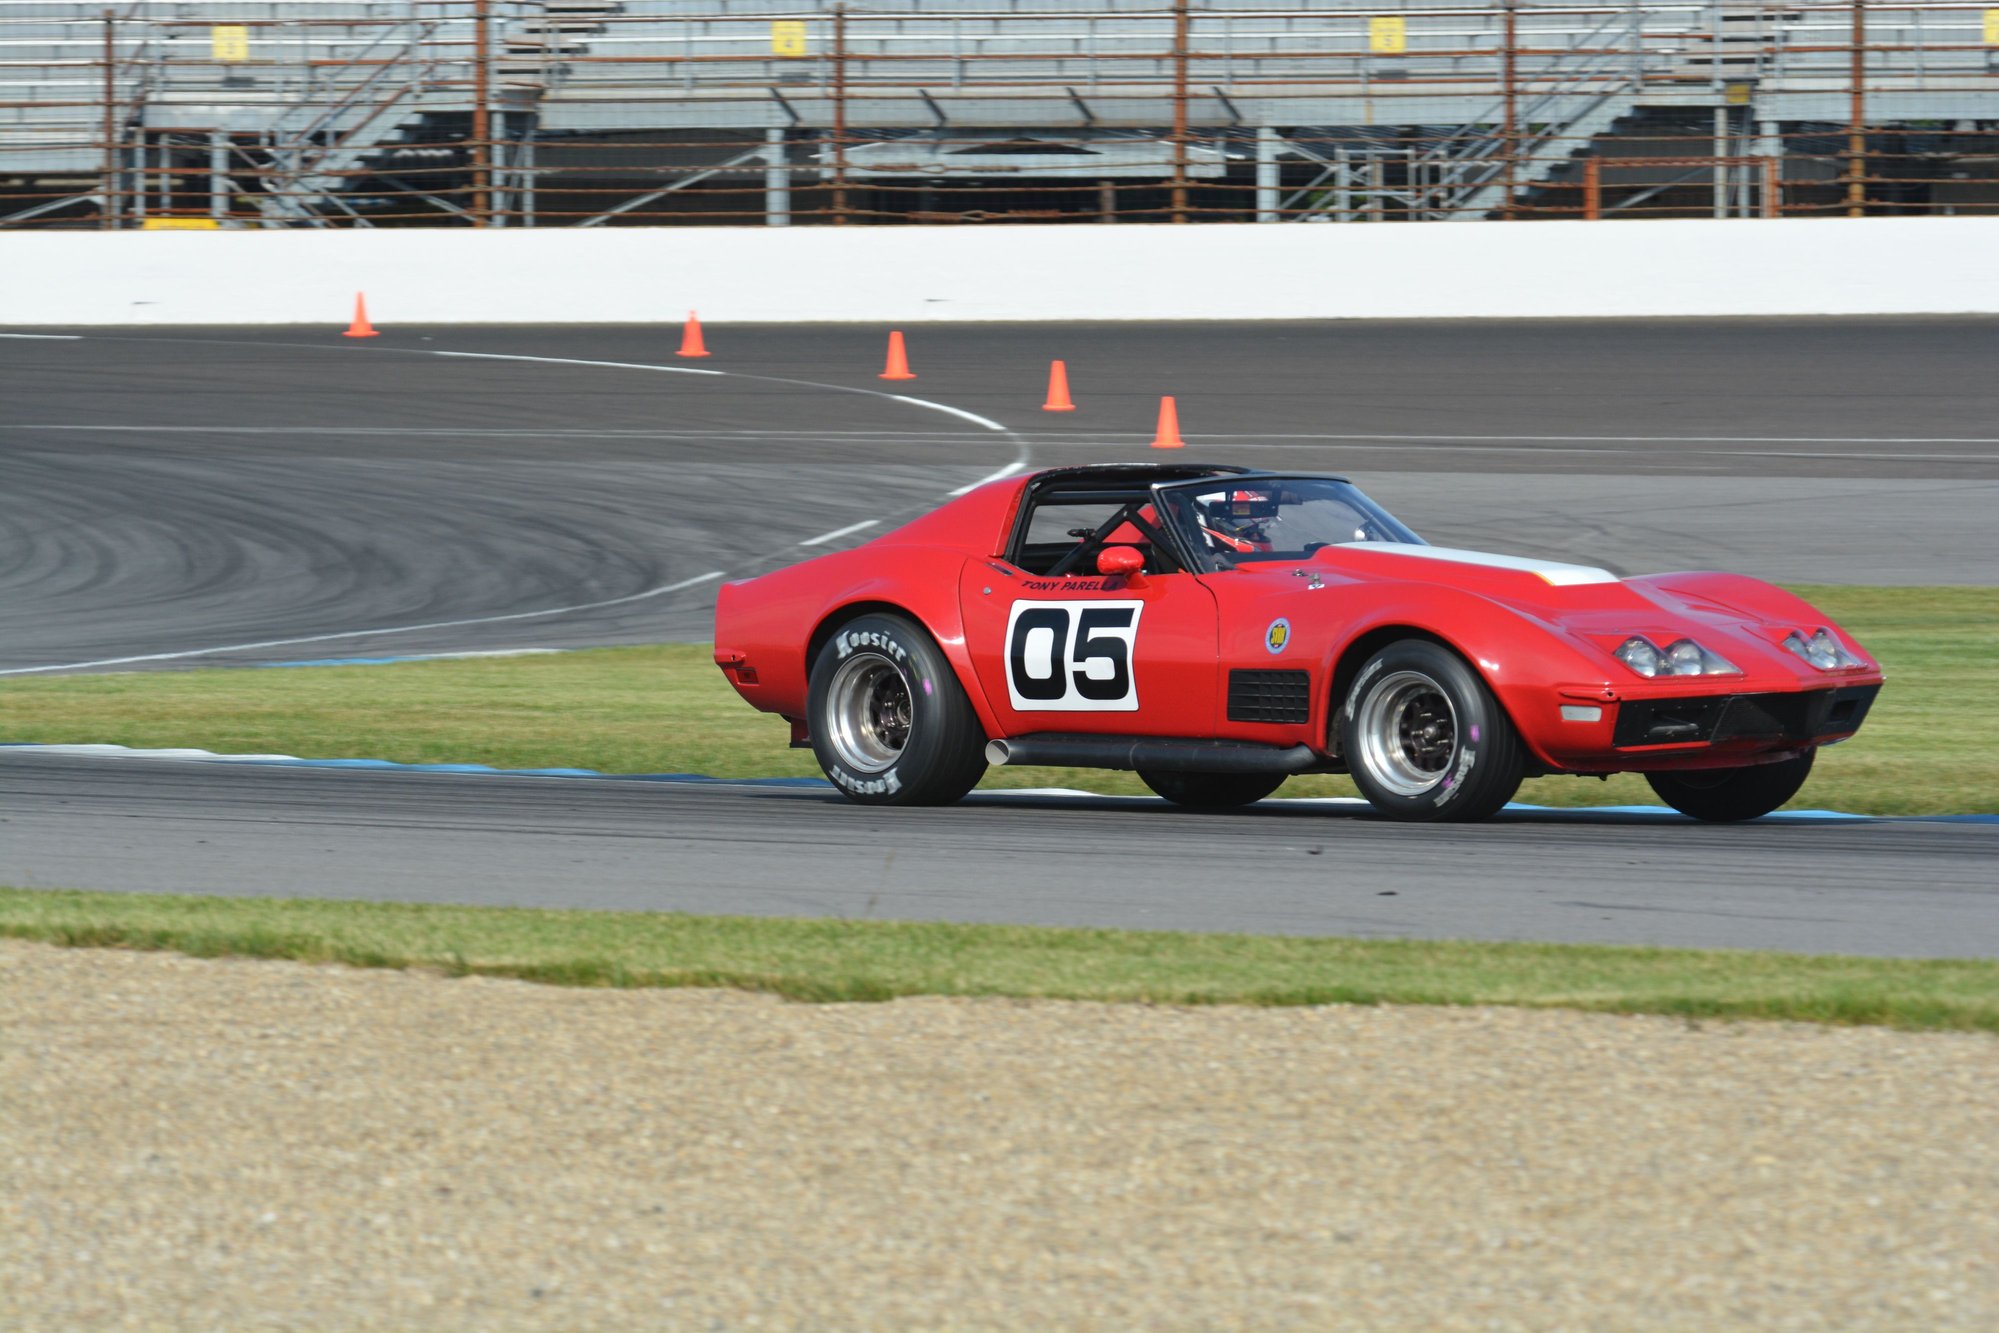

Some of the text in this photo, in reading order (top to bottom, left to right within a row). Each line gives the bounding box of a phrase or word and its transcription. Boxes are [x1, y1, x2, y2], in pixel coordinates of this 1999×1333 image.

[1022, 580, 1060, 592] TONY
[835, 630, 907, 661] Hoosier
[1010, 607, 1135, 700] 05
